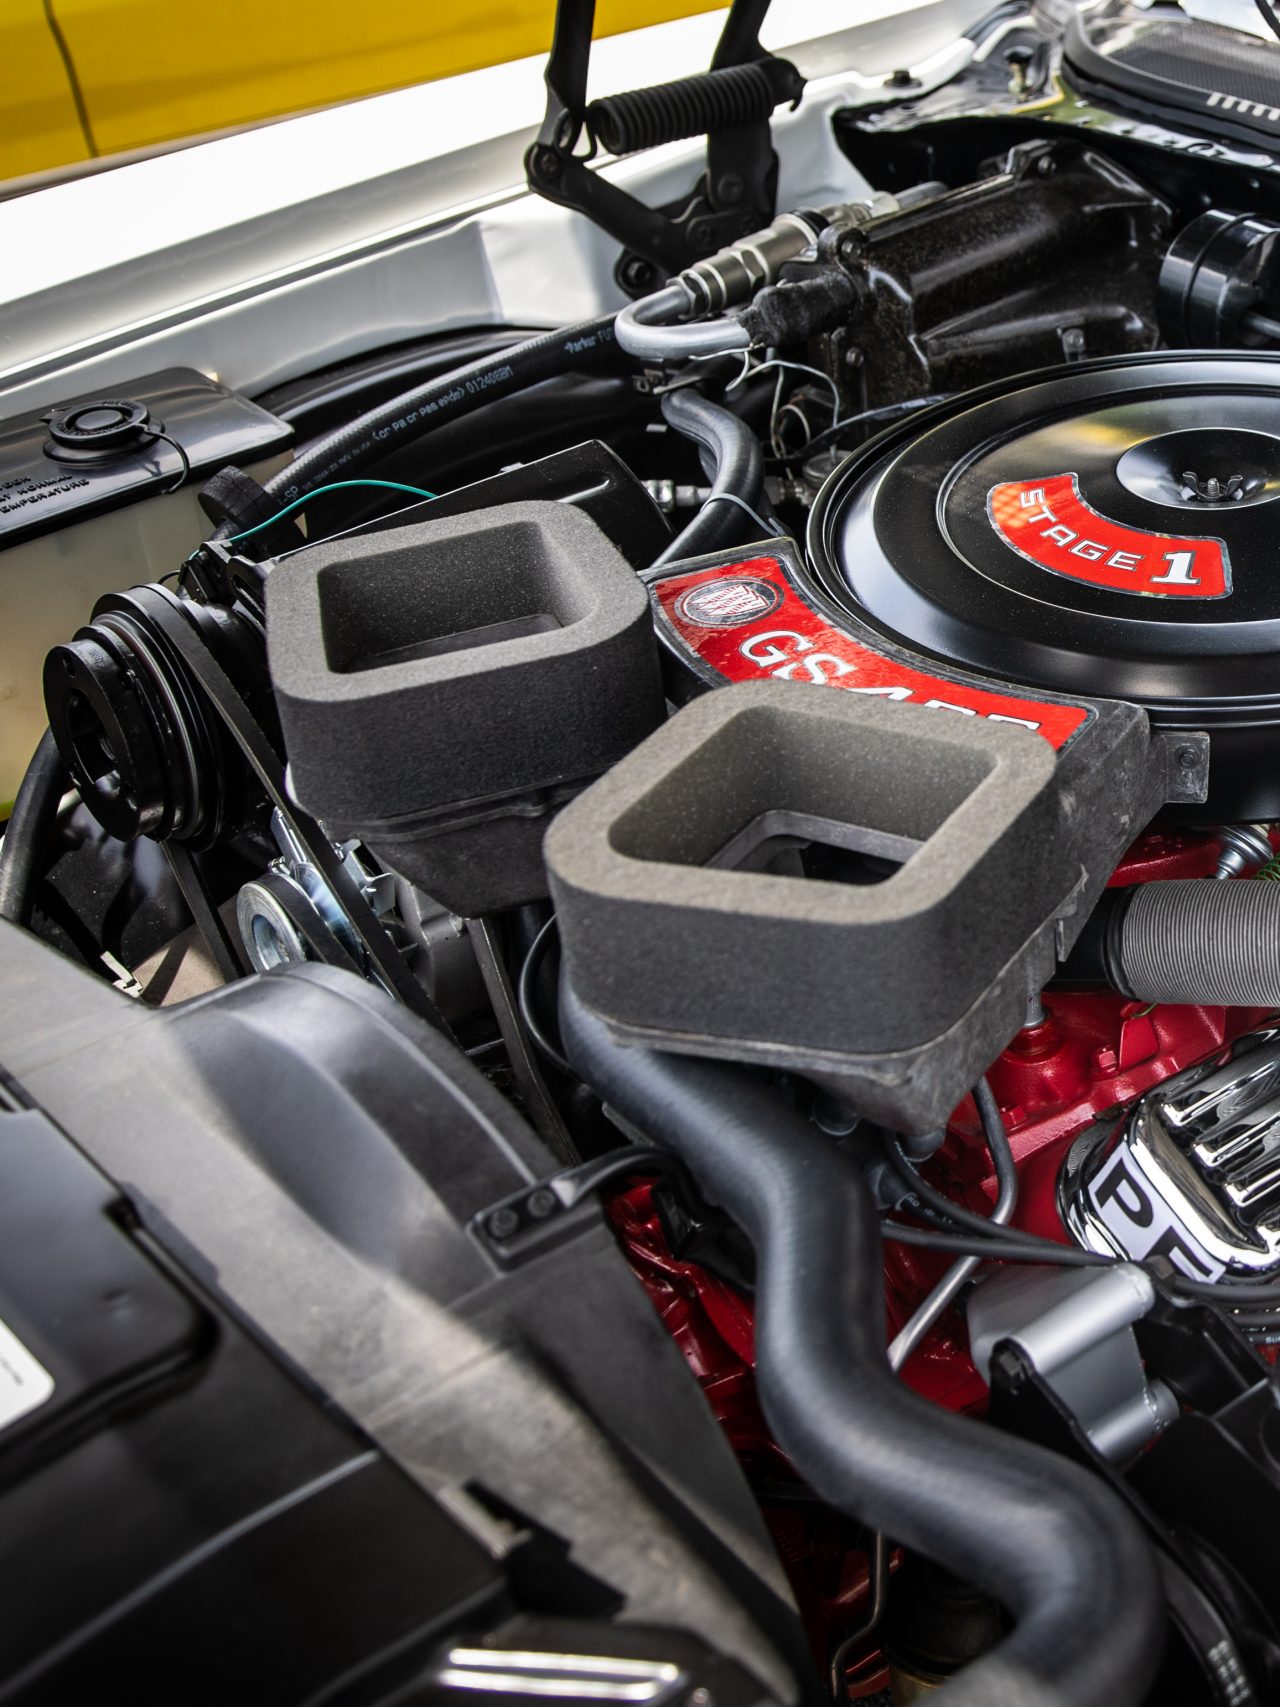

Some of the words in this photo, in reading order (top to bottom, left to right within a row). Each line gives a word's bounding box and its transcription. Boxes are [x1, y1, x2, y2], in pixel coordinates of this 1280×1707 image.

[17, 475, 73, 496] NORMAL
[1019, 487, 1145, 572] STAGE
[1150, 550, 1202, 586] 1
